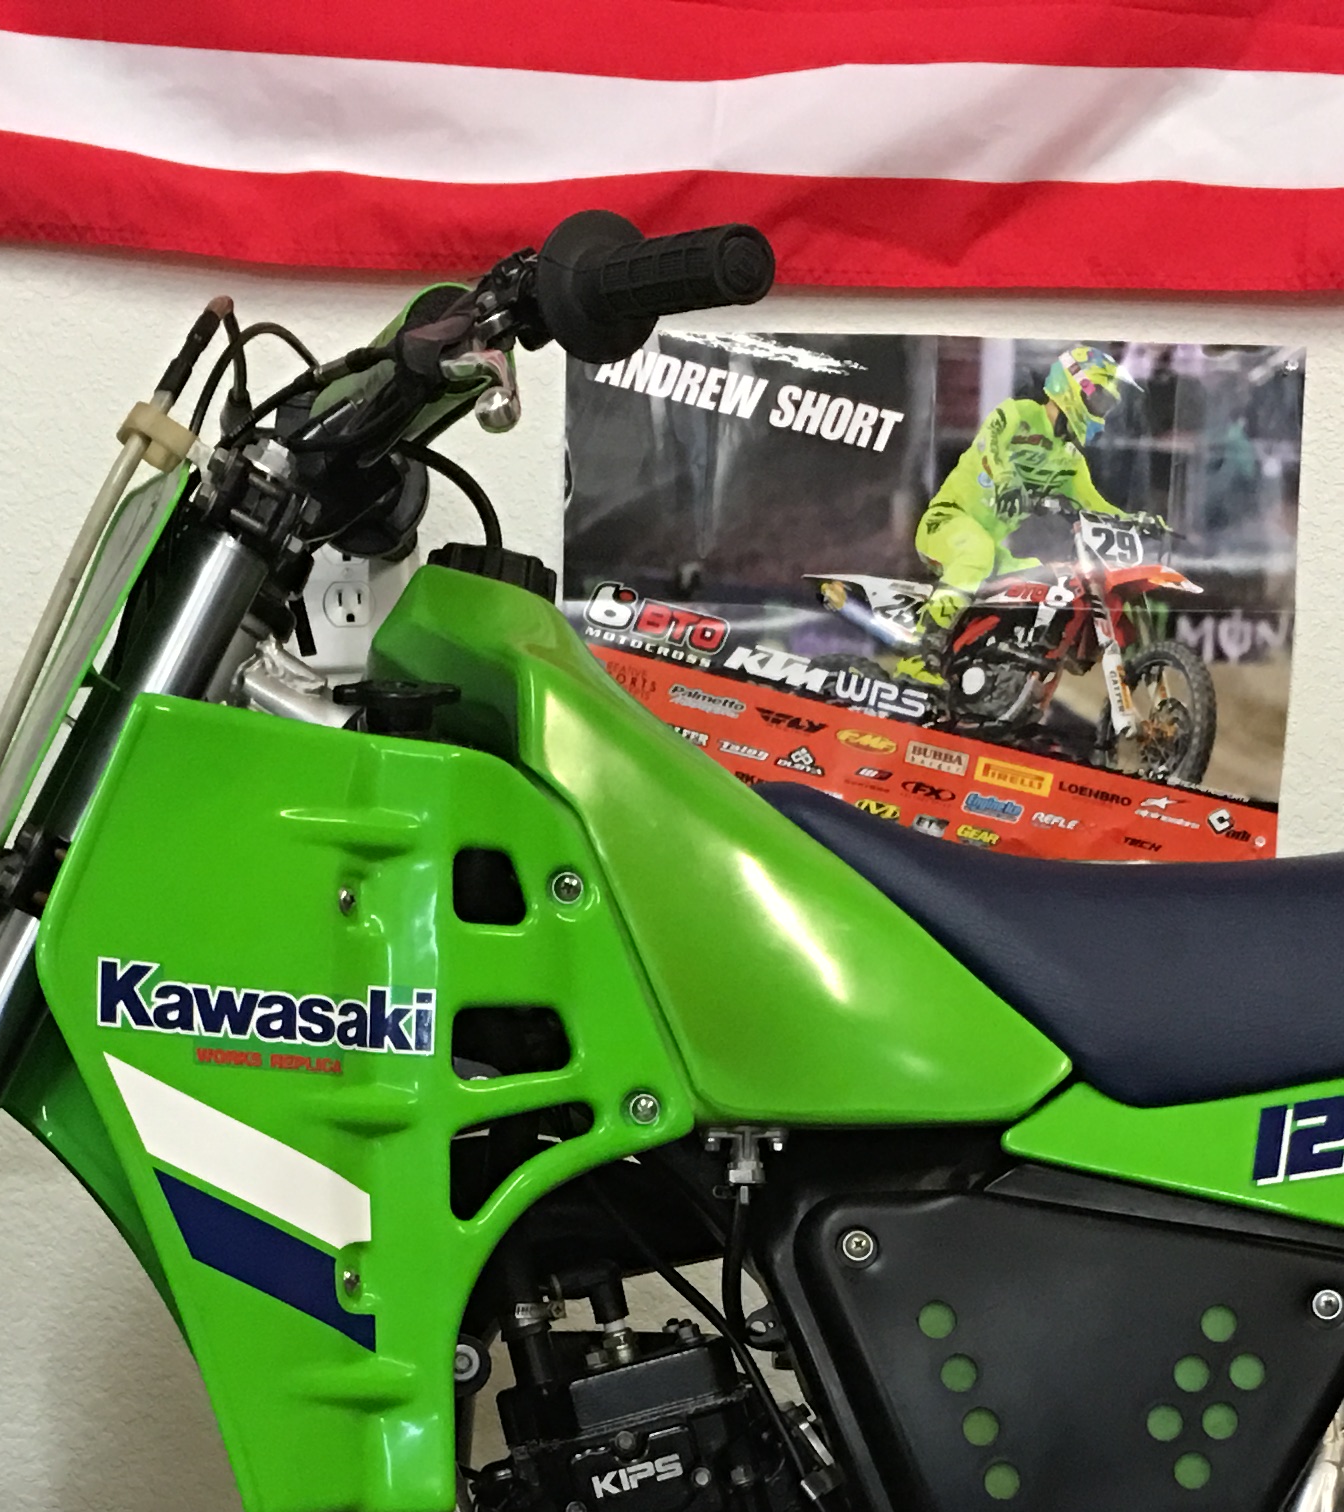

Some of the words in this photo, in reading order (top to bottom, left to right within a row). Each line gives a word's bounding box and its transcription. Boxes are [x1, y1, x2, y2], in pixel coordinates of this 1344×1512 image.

[595, 349, 768, 420] ANDREW
[768, 385, 905, 453] SHORT
[1091, 526, 1138, 566] 29
[584, 625, 712, 668] MOTOCROSS
[634, 601, 729, 653] BTO
[723, 645, 830, 693] KTM
[670, 685, 745, 711] Palmetto
[835, 669, 929, 718] WPS
[911, 744, 963, 766] BUBBA
[982, 763, 1046, 790] PIRELLI
[1058, 780, 1132, 807] LOENBRO
[957, 824, 1001, 845] GEAR
[96, 956, 437, 1056] Kawasaki
[196, 1047, 262, 1067] WORKS
[269, 1053, 342, 1073] REPLICA
[591, 1453, 684, 1499] KIPS
